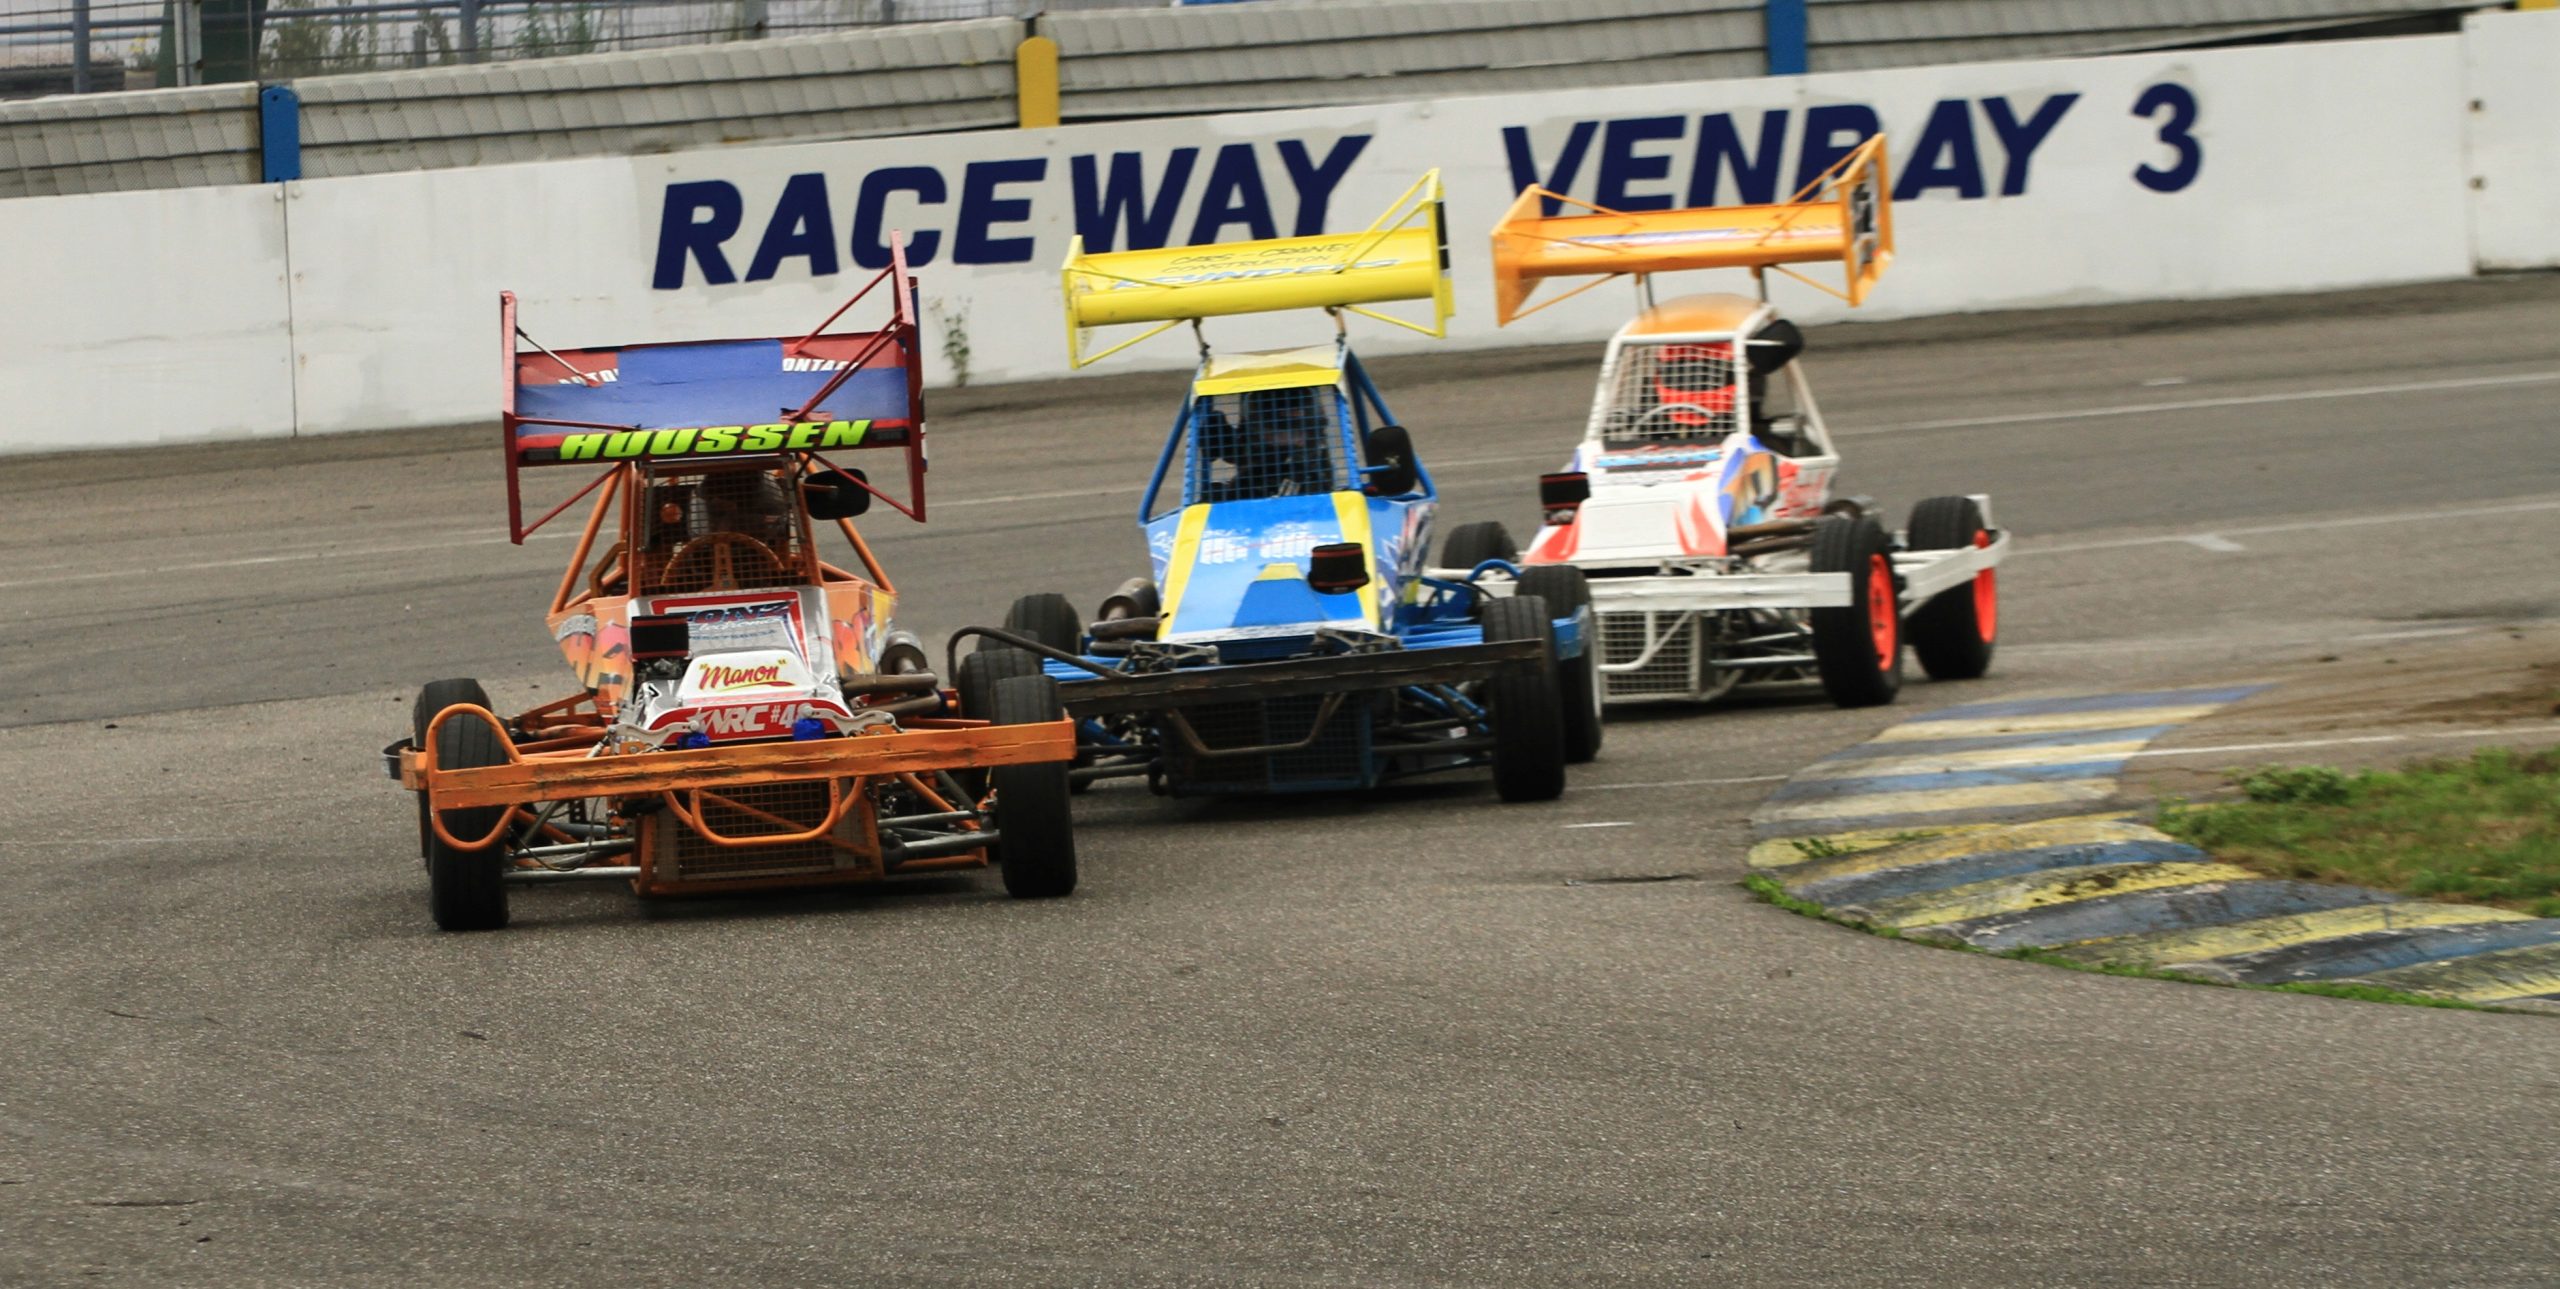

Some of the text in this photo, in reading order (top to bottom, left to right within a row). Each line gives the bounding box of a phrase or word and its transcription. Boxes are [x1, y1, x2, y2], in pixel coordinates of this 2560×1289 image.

[1501, 92, 2083, 217] VENRAY
[2130, 83, 2203, 193] 3
[559, 419, 872, 460] HUUSSEN
